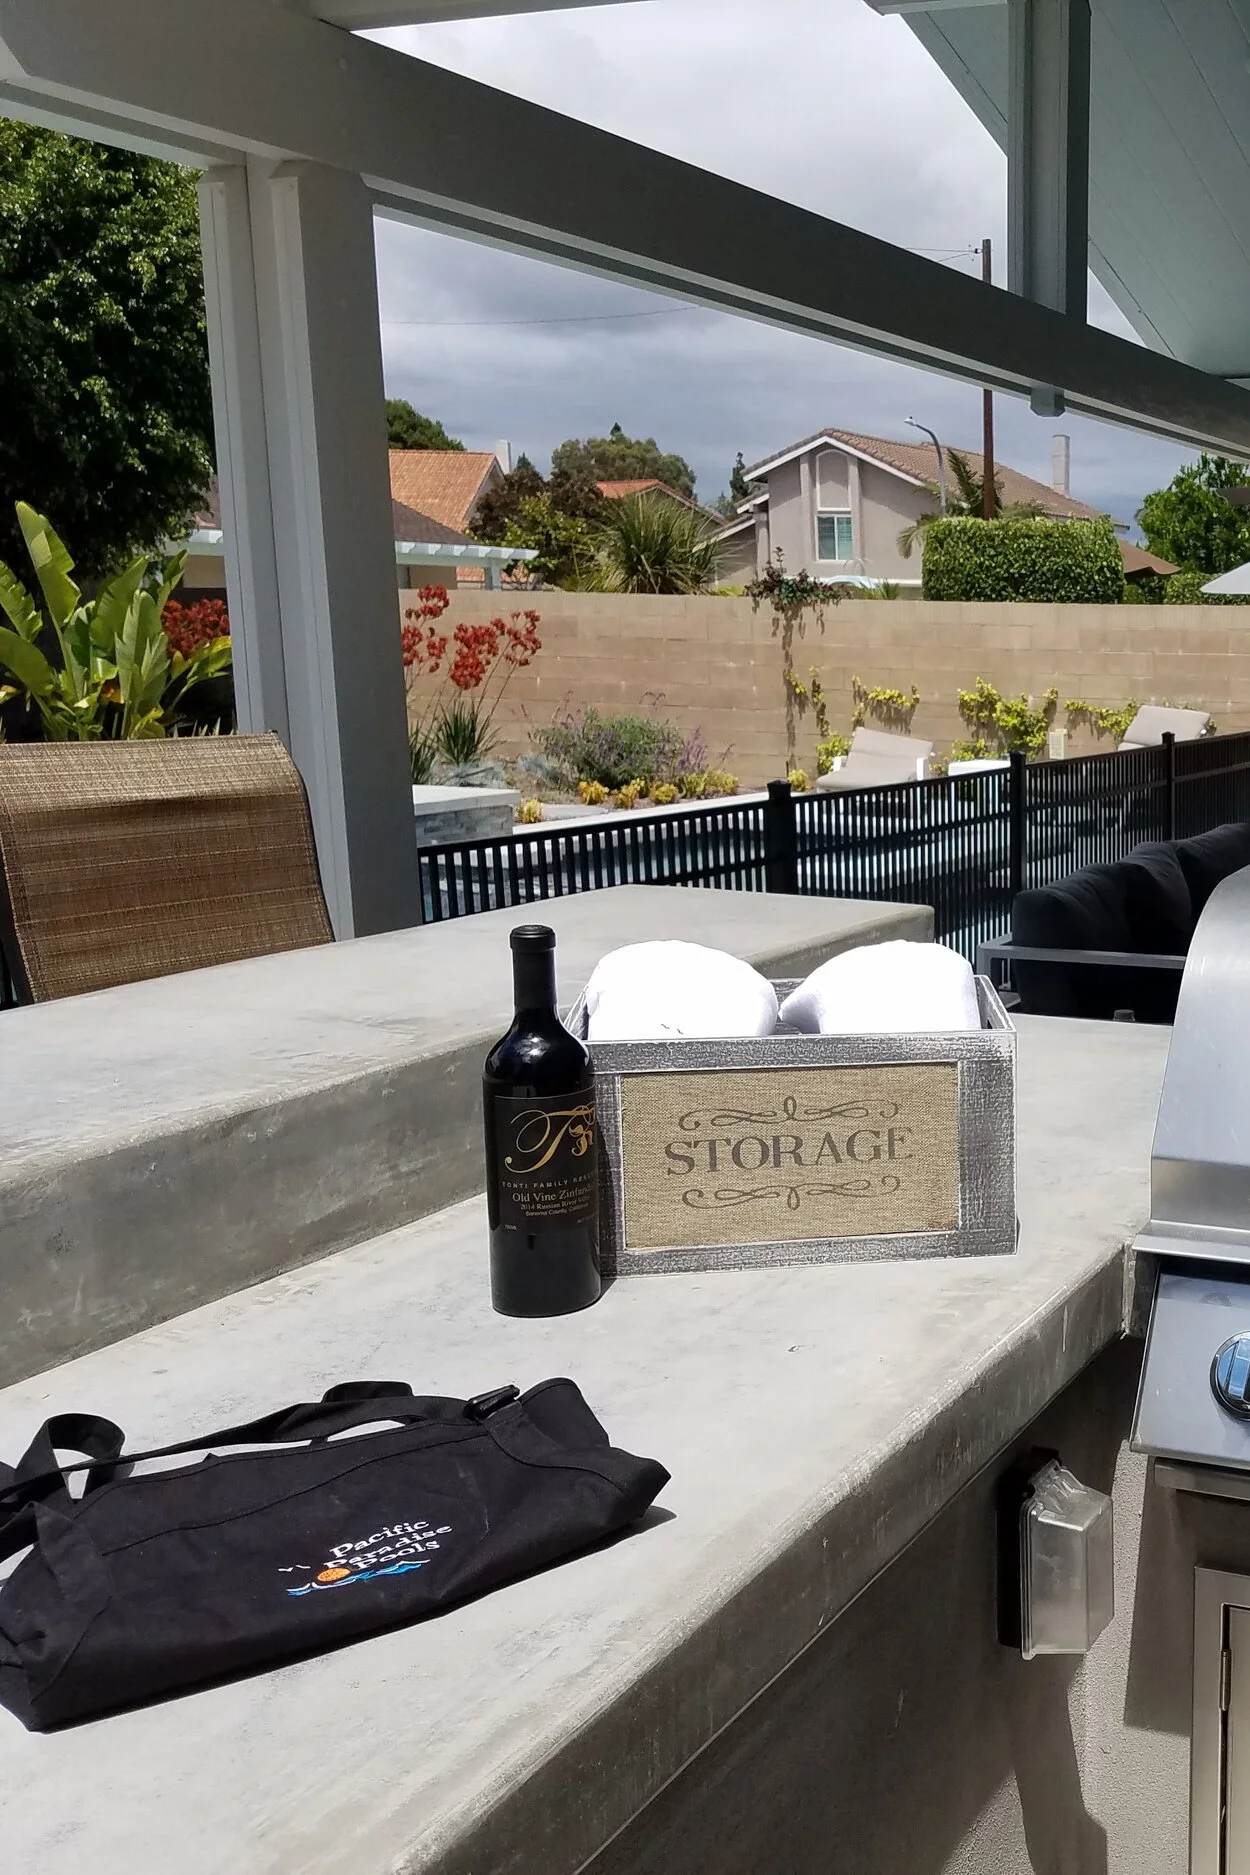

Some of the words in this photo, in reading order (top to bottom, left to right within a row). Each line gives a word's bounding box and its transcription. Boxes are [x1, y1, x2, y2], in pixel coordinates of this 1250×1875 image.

[665, 1126, 913, 1176] STORAGE
[502, 1181, 528, 1189] TONTI
[533, 1179, 568, 1189] FAMILY
[512, 1192, 530, 1202] Old
[533, 1193, 556, 1202] Vine
[323, 1525, 452, 1569] Paradise
[329, 1521, 429, 1558] Pacific
[352, 1540, 440, 1569] Pools
